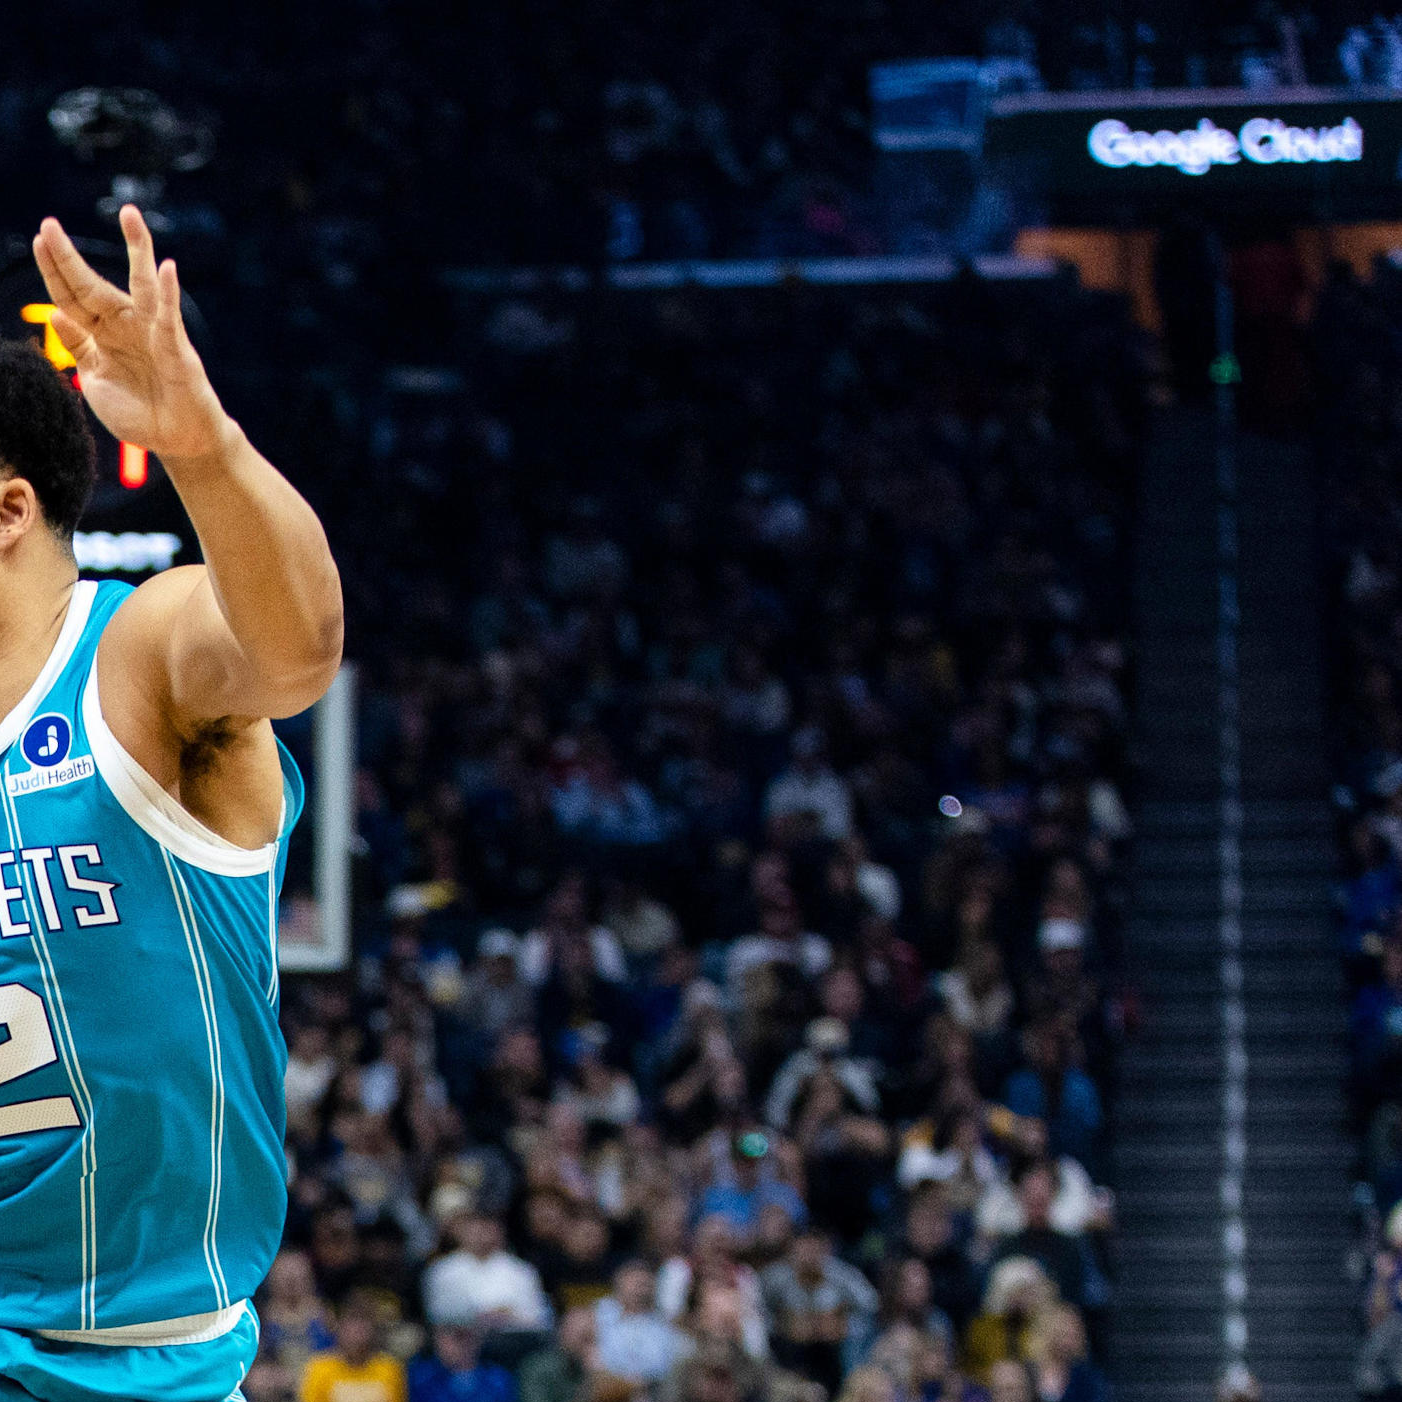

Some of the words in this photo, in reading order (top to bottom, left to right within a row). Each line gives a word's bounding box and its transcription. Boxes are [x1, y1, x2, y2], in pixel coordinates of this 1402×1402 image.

[1087, 118, 1241, 176] Google
[1239, 116, 1364, 165] Cloud
[47, 759, 92, 784] Health
